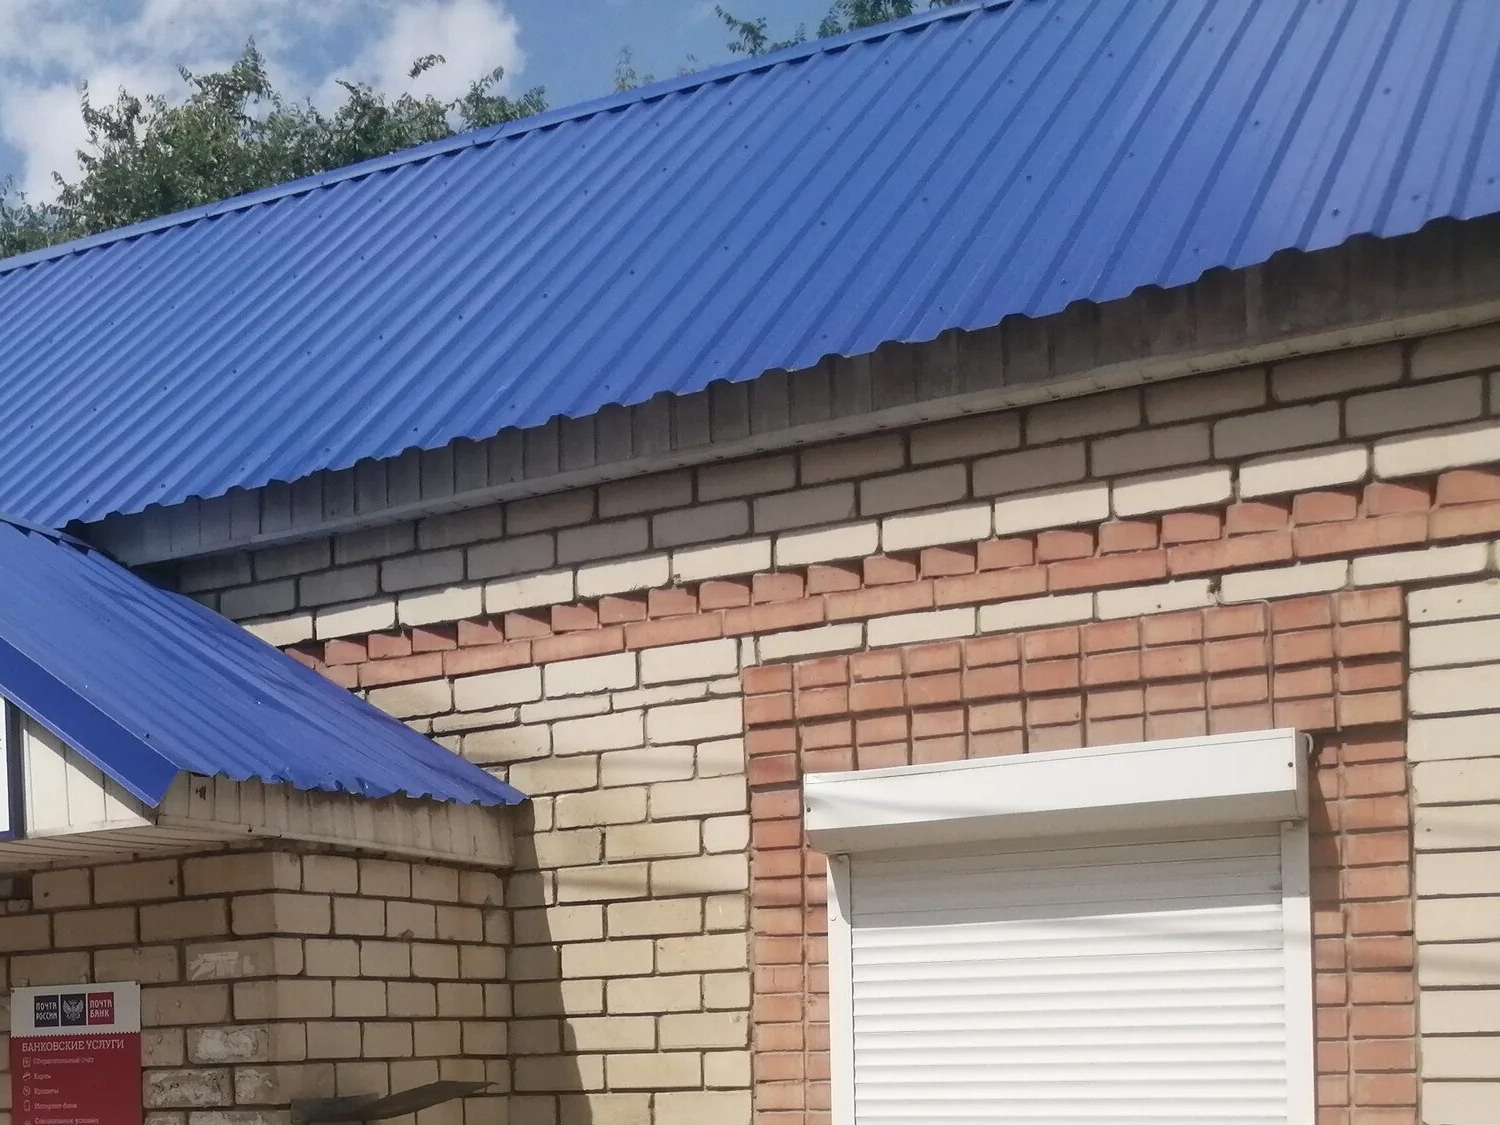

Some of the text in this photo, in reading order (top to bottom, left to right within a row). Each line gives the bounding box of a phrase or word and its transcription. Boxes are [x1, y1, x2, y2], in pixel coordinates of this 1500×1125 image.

[36, 1001, 57, 1011] ПОЧТА
[89, 999, 113, 1009] ПОЧТА
[36, 1011, 58, 1021] РОССИИ
[90, 1009, 110, 1018] БАНК
[22, 1039, 125, 1053] БАНКОВСКИЕ УСЛУГИ
